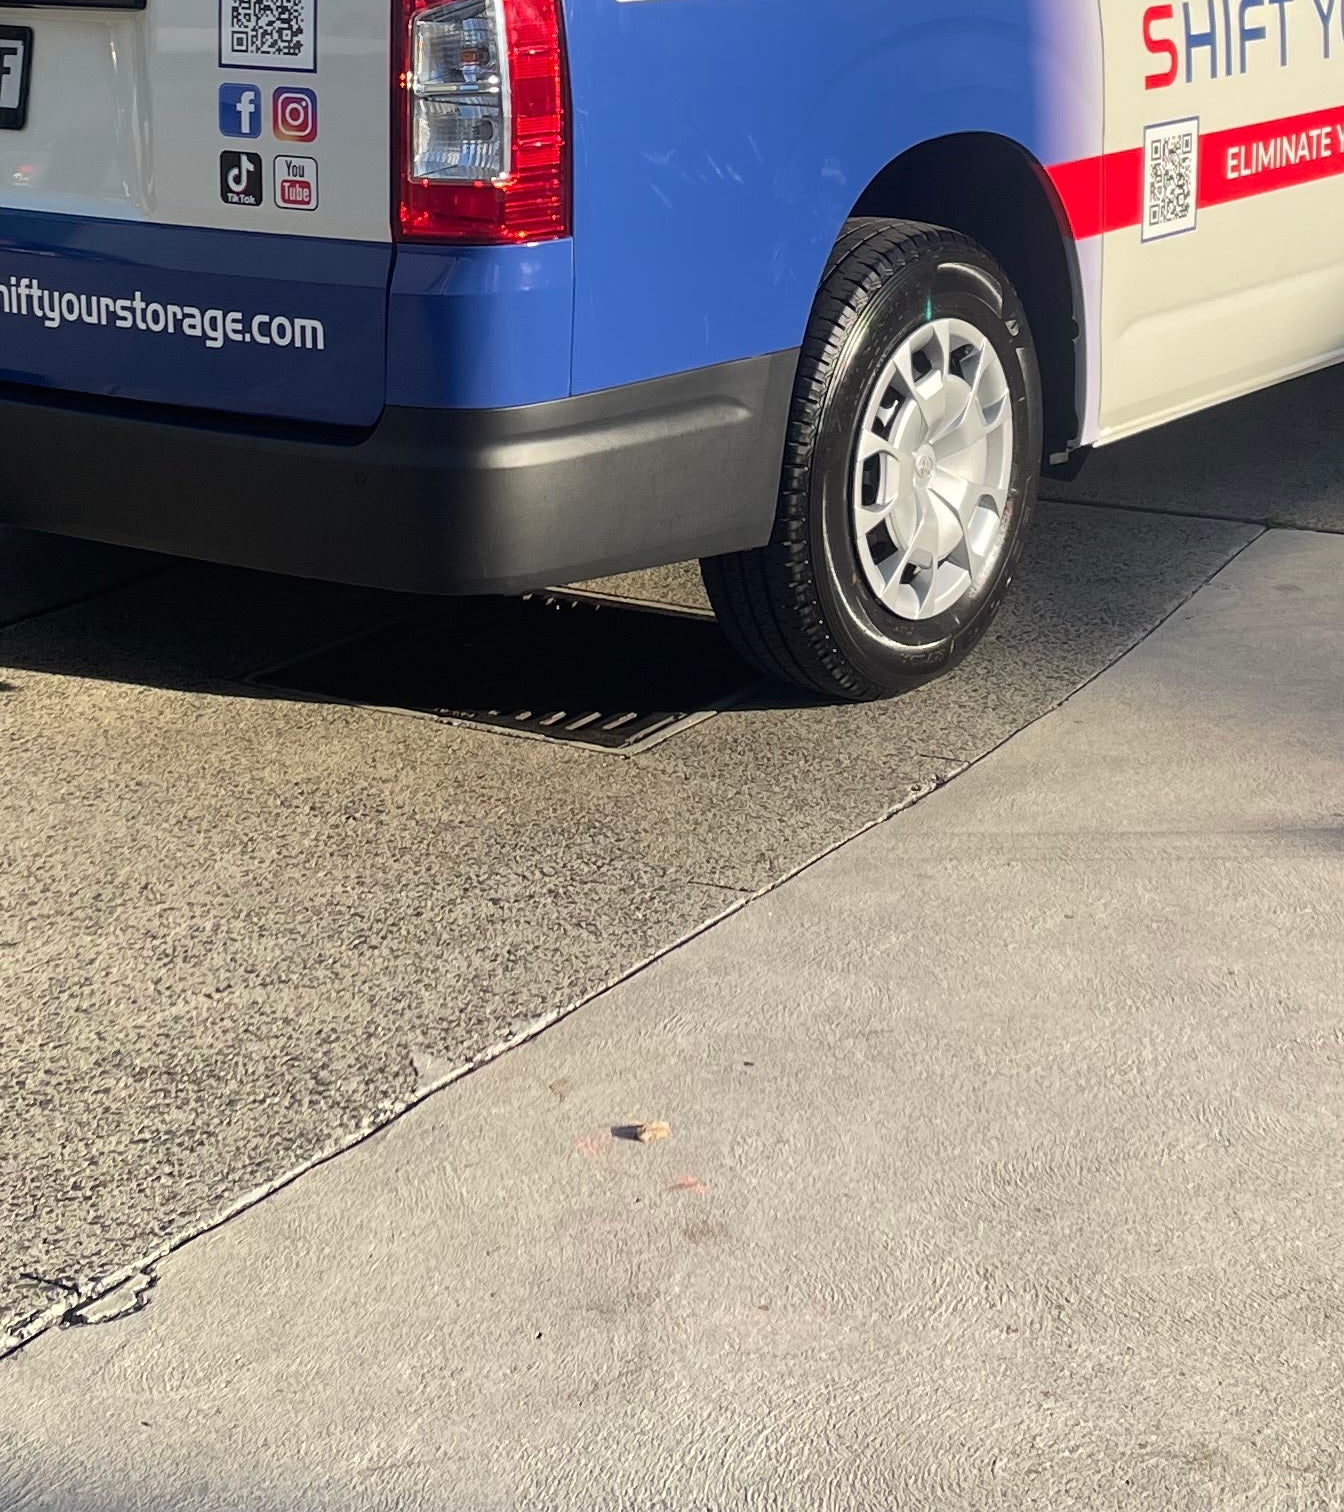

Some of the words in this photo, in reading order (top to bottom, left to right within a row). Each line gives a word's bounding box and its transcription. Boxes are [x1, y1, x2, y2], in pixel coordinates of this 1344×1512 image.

[1226, 126, 1332, 180] ELIMINATE
[284, 160, 305, 178] You
[227, 192, 256, 205] TikTok
[282, 182, 310, 202] Tube
